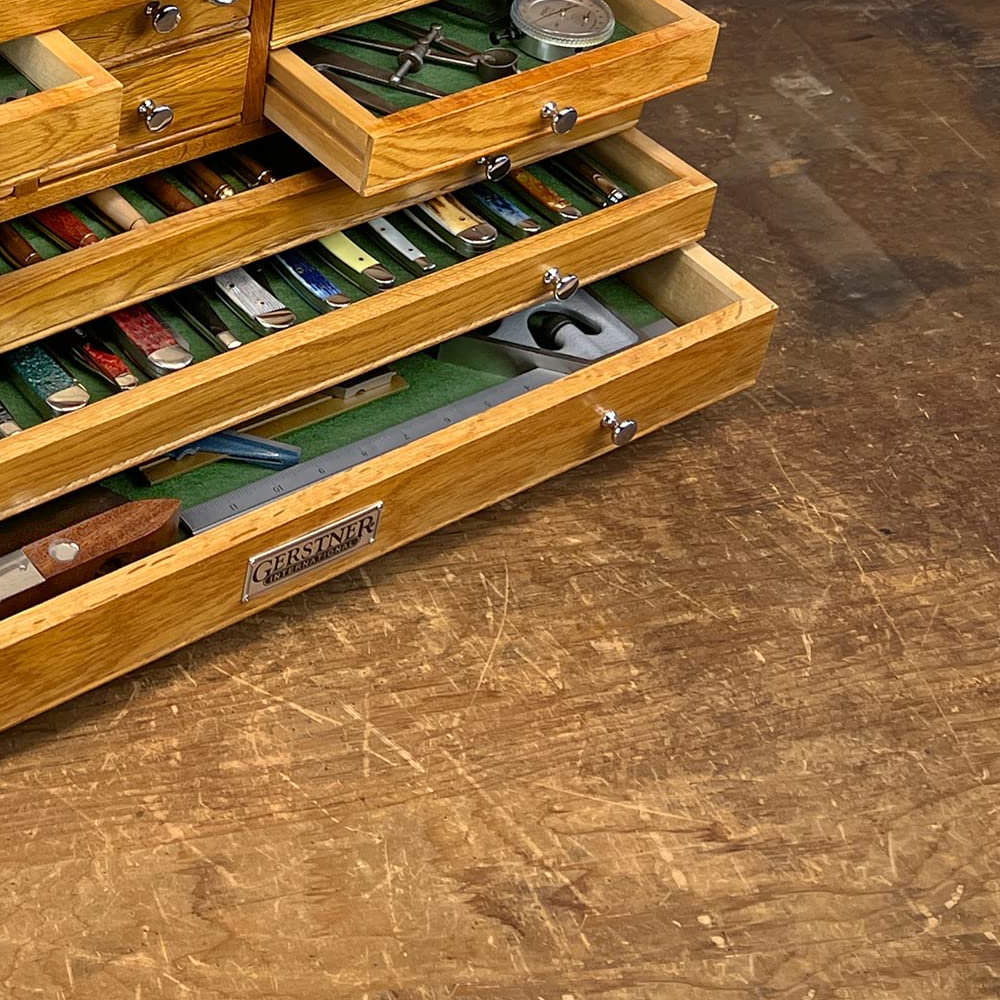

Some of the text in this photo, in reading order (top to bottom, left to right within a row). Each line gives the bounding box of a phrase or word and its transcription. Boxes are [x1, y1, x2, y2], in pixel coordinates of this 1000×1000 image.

[272, 484, 283, 493] 10
[229, 503, 239, 511] 11
[252, 516, 374, 582] GERSTNER
